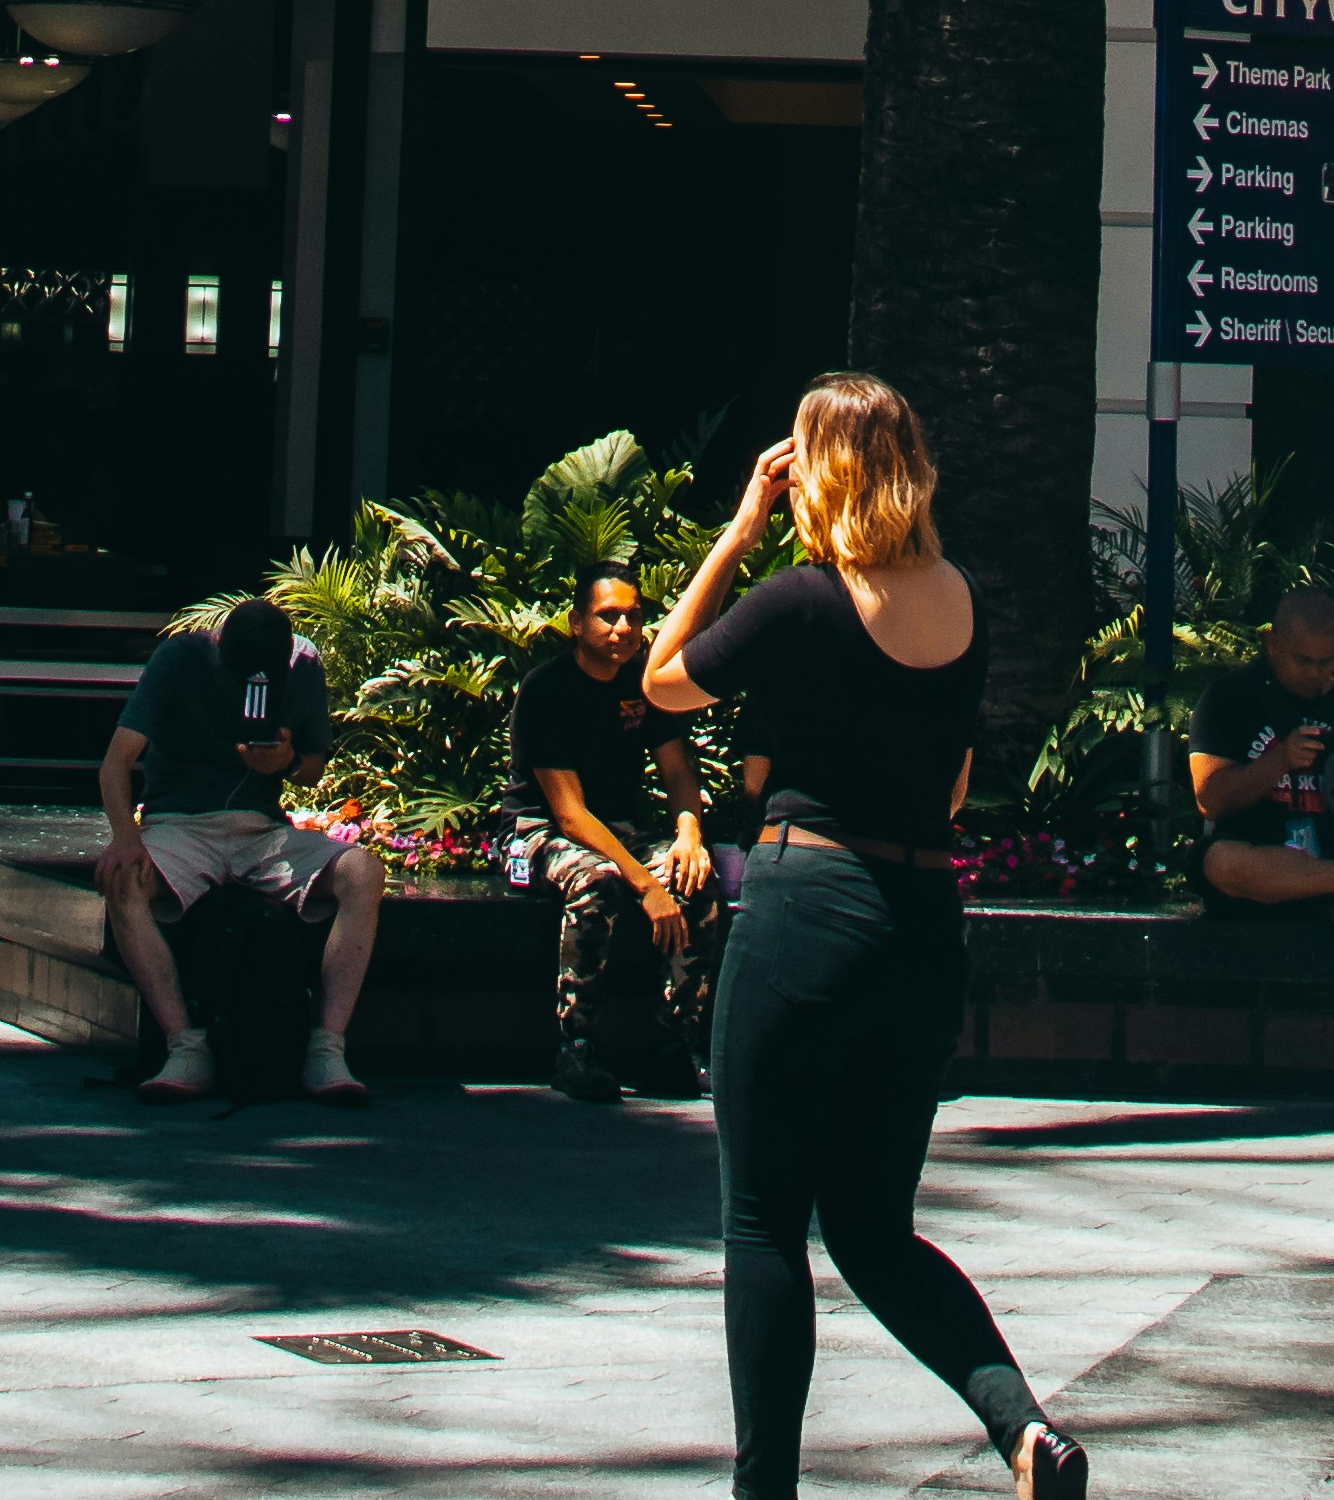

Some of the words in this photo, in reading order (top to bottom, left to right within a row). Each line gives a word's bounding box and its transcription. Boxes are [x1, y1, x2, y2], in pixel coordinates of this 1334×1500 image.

[1226, 60, 1289, 88] Theme
[1293, 64, 1332, 92] Park
[1226, 111, 1309, 139] Cinemas
[1220, 163, 1295, 195] Parking
[1220, 215, 1295, 247] Parking
[1220, 266, 1319, 294] Restrooms
[1220, 318, 1281, 344] Sheriff
